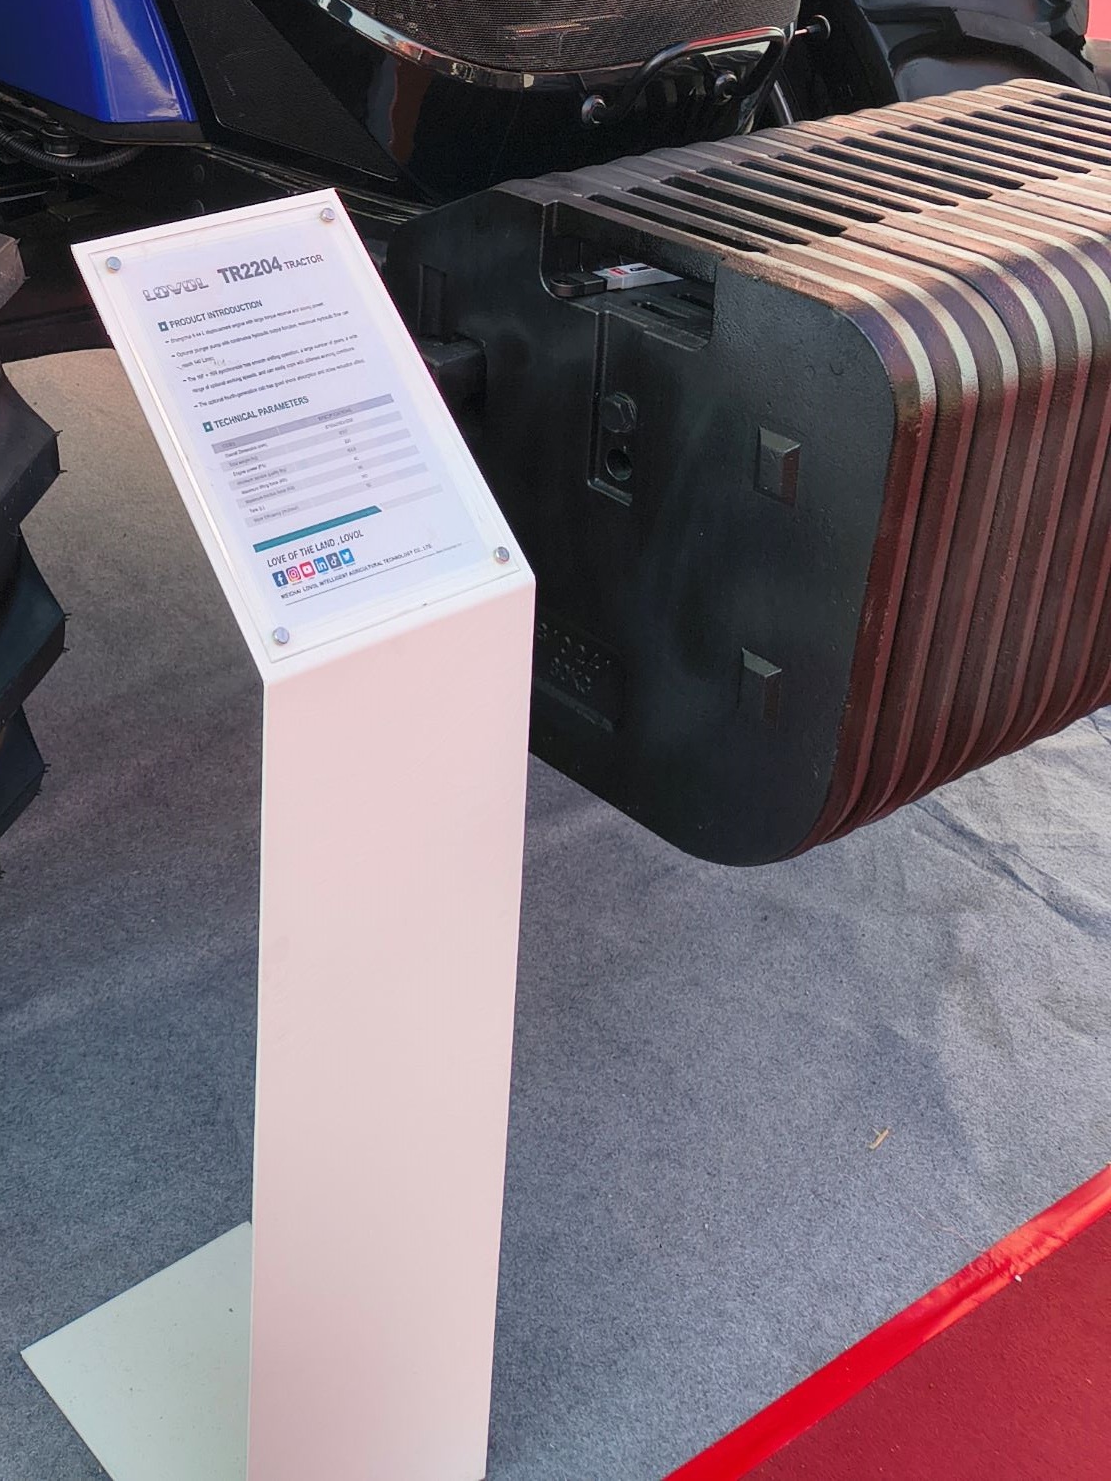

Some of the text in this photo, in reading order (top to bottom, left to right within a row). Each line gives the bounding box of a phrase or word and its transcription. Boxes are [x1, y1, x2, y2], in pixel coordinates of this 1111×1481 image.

[142, 254, 324, 302] LOVOL TR2204 TRACTOR
[168, 313, 206, 329] PRODUCT
[206, 300, 263, 319] INTRODUCTION
[213, 410, 258, 429] TECHNICAL
[257, 395, 309, 416] PARAMETERS
[266, 554, 287, 568] LOVE
[287, 550, 299, 561] OF
[298, 545, 315, 557] THE
[314, 538, 336, 552] LAND
[339, 529, 364, 544] LOVOL
